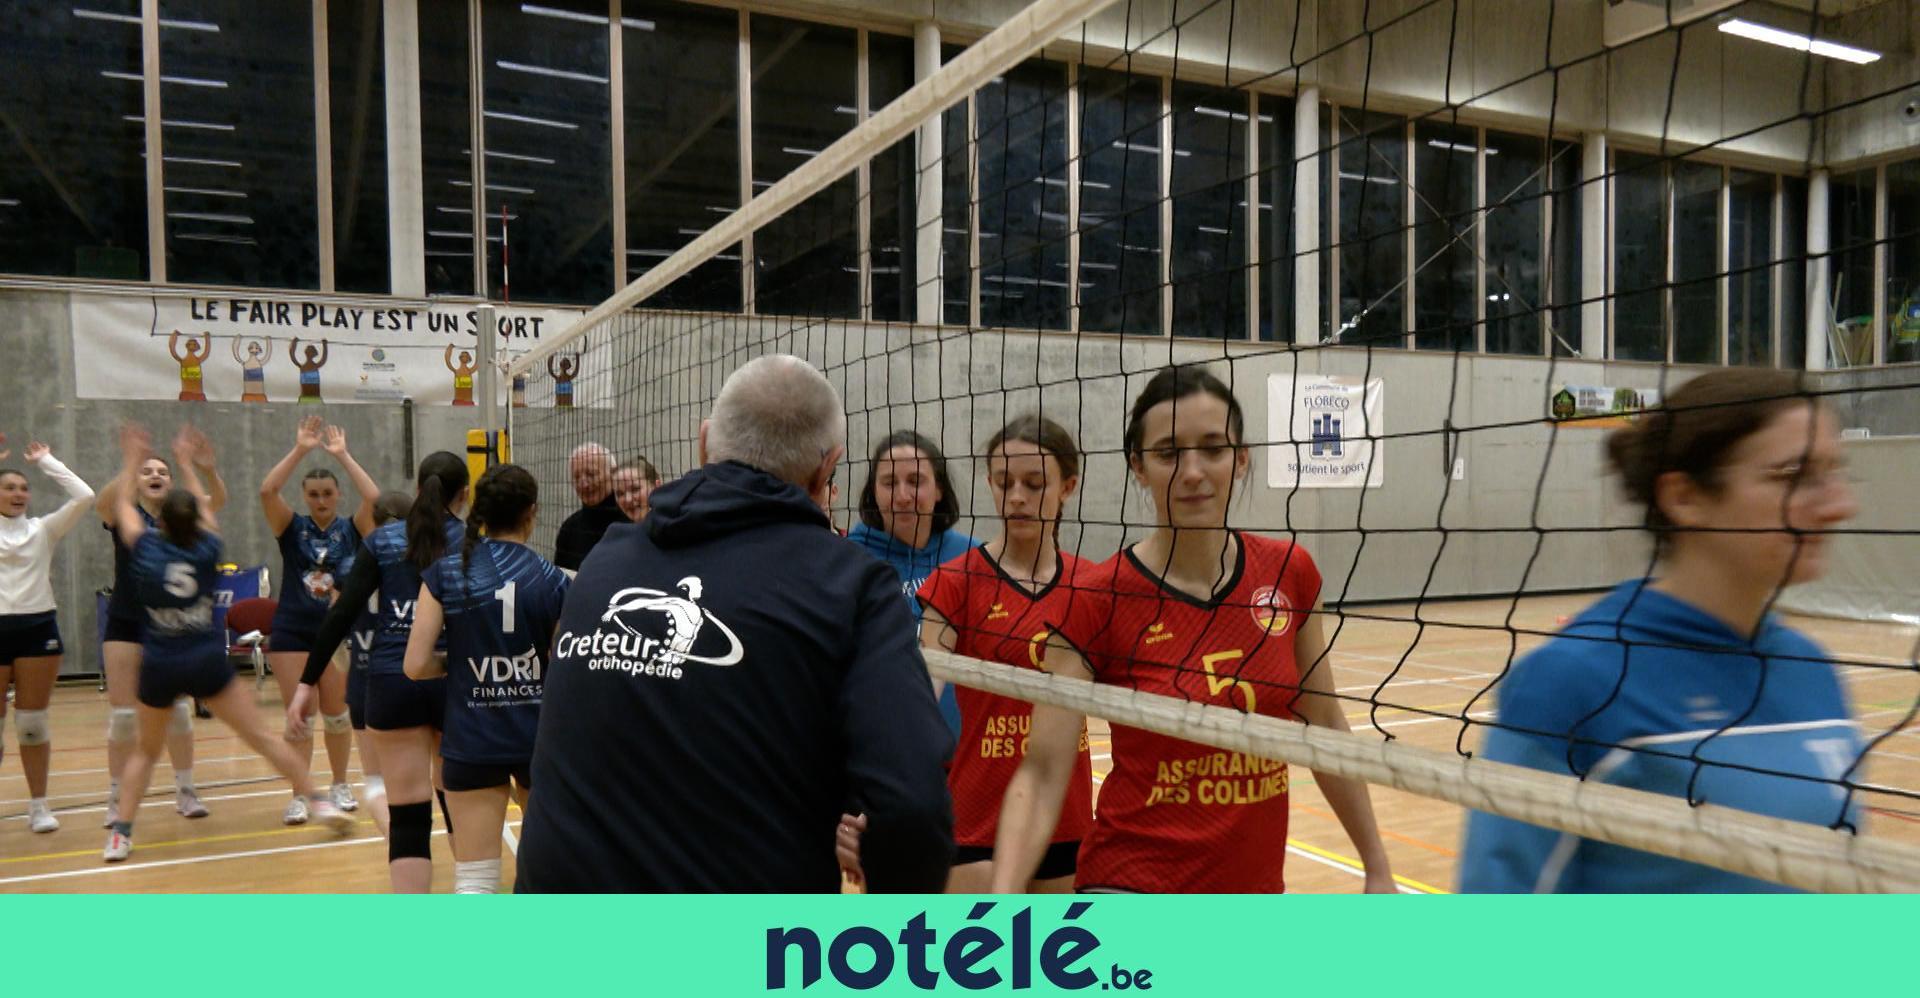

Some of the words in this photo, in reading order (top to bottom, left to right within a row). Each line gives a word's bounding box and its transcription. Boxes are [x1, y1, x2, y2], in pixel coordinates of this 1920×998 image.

[190, 298, 218, 321] LE
[230, 299, 292, 326] FAIR
[302, 302, 363, 330] PLAY
[373, 309, 418, 331] EST
[428, 311, 458, 333] UN
[466, 311, 544, 338] SORT
[1288, 463, 1327, 475] soutient
[1330, 464, 1338, 474] le
[1341, 462, 1365, 475] sport
[163, 562, 198, 598] 5
[494, 581, 516, 633] 1
[557, 628, 660, 659] Creteur
[472, 685, 543, 698] FINANCES
[1202, 649, 1256, 713] 5
[981, 737, 1015, 758] DES
